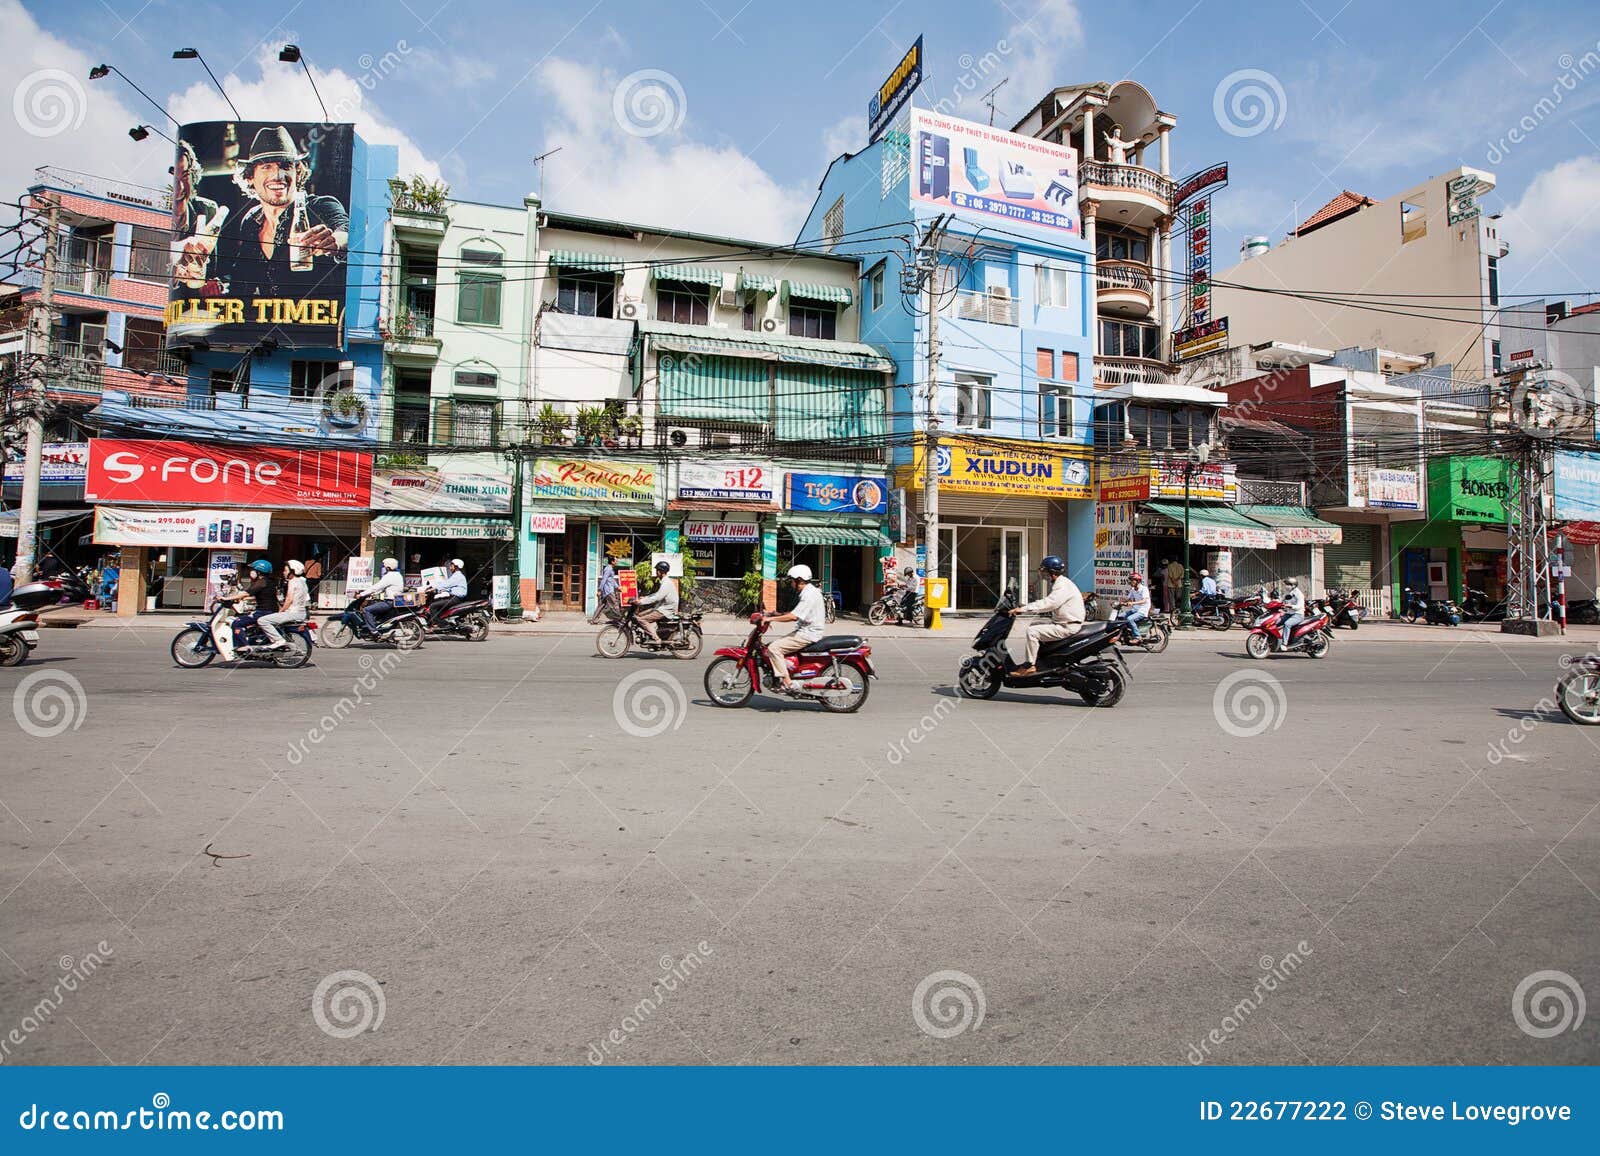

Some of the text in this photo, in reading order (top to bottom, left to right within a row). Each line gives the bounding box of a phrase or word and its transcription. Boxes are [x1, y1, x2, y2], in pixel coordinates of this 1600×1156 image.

[252, 299, 338, 324] TIME!
[558, 461, 653, 485] Karaoke
[724, 467, 763, 489] 512
[966, 457, 1053, 479] XIUDUN
[445, 484, 478, 494] THANH
[804, 482, 848, 506] Tiger
[392, 524, 411, 535] NHÀ
[451, 527, 480, 537] THANH
[532, 516, 564, 530] KARAOKE
[689, 522, 709, 535] HÁT
[730, 524, 755, 536] NHAU
